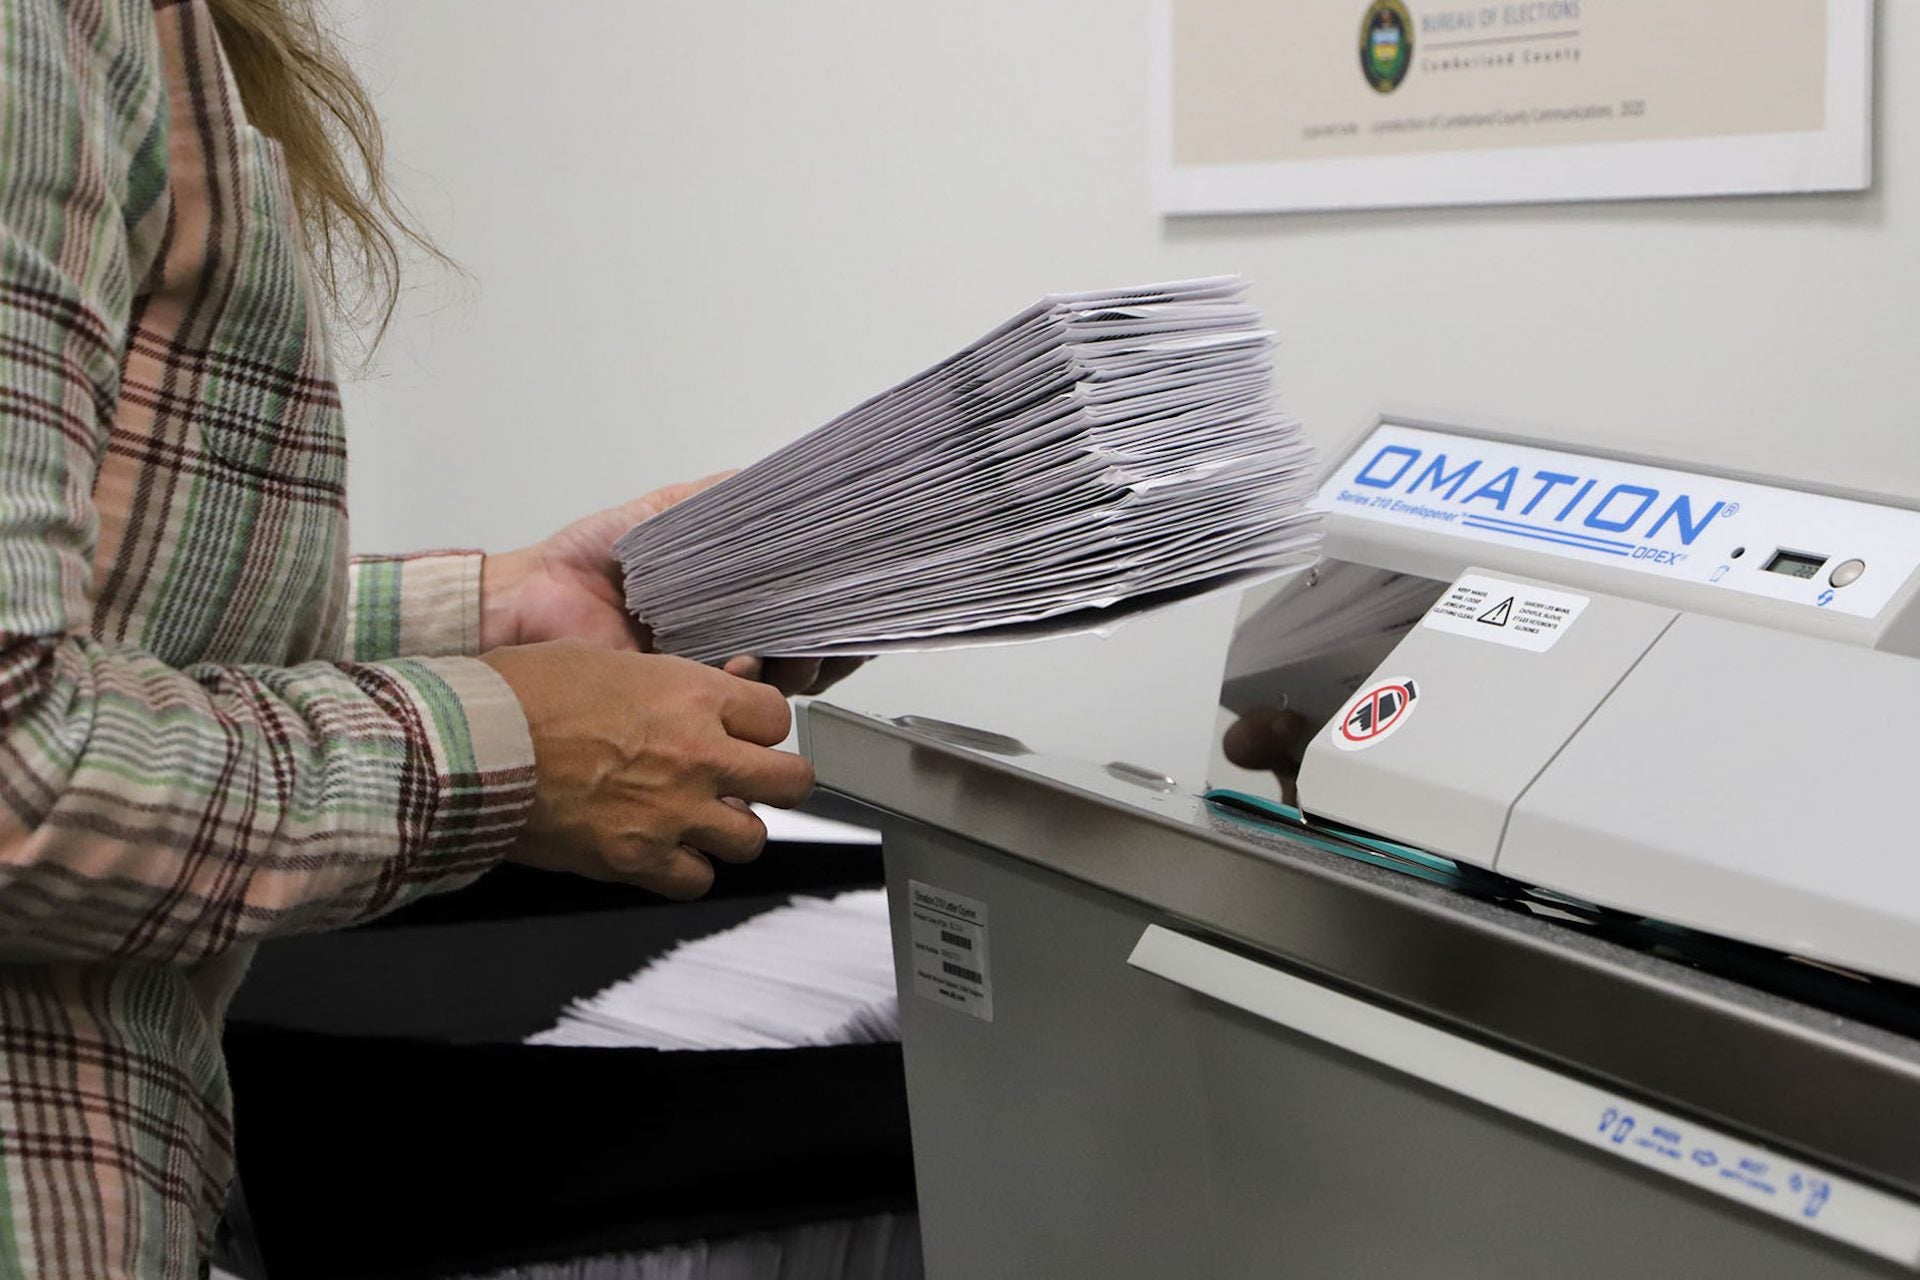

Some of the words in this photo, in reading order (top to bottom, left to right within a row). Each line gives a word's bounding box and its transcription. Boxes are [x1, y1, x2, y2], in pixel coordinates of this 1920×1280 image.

[1421, 11, 1473, 31] BUREAU
[1479, 7, 1497, 27] OF
[1503, 1, 1581, 26] ELECTIONS
[1523, 48, 1581, 64] County
[1337, 490, 1369, 505] Series
